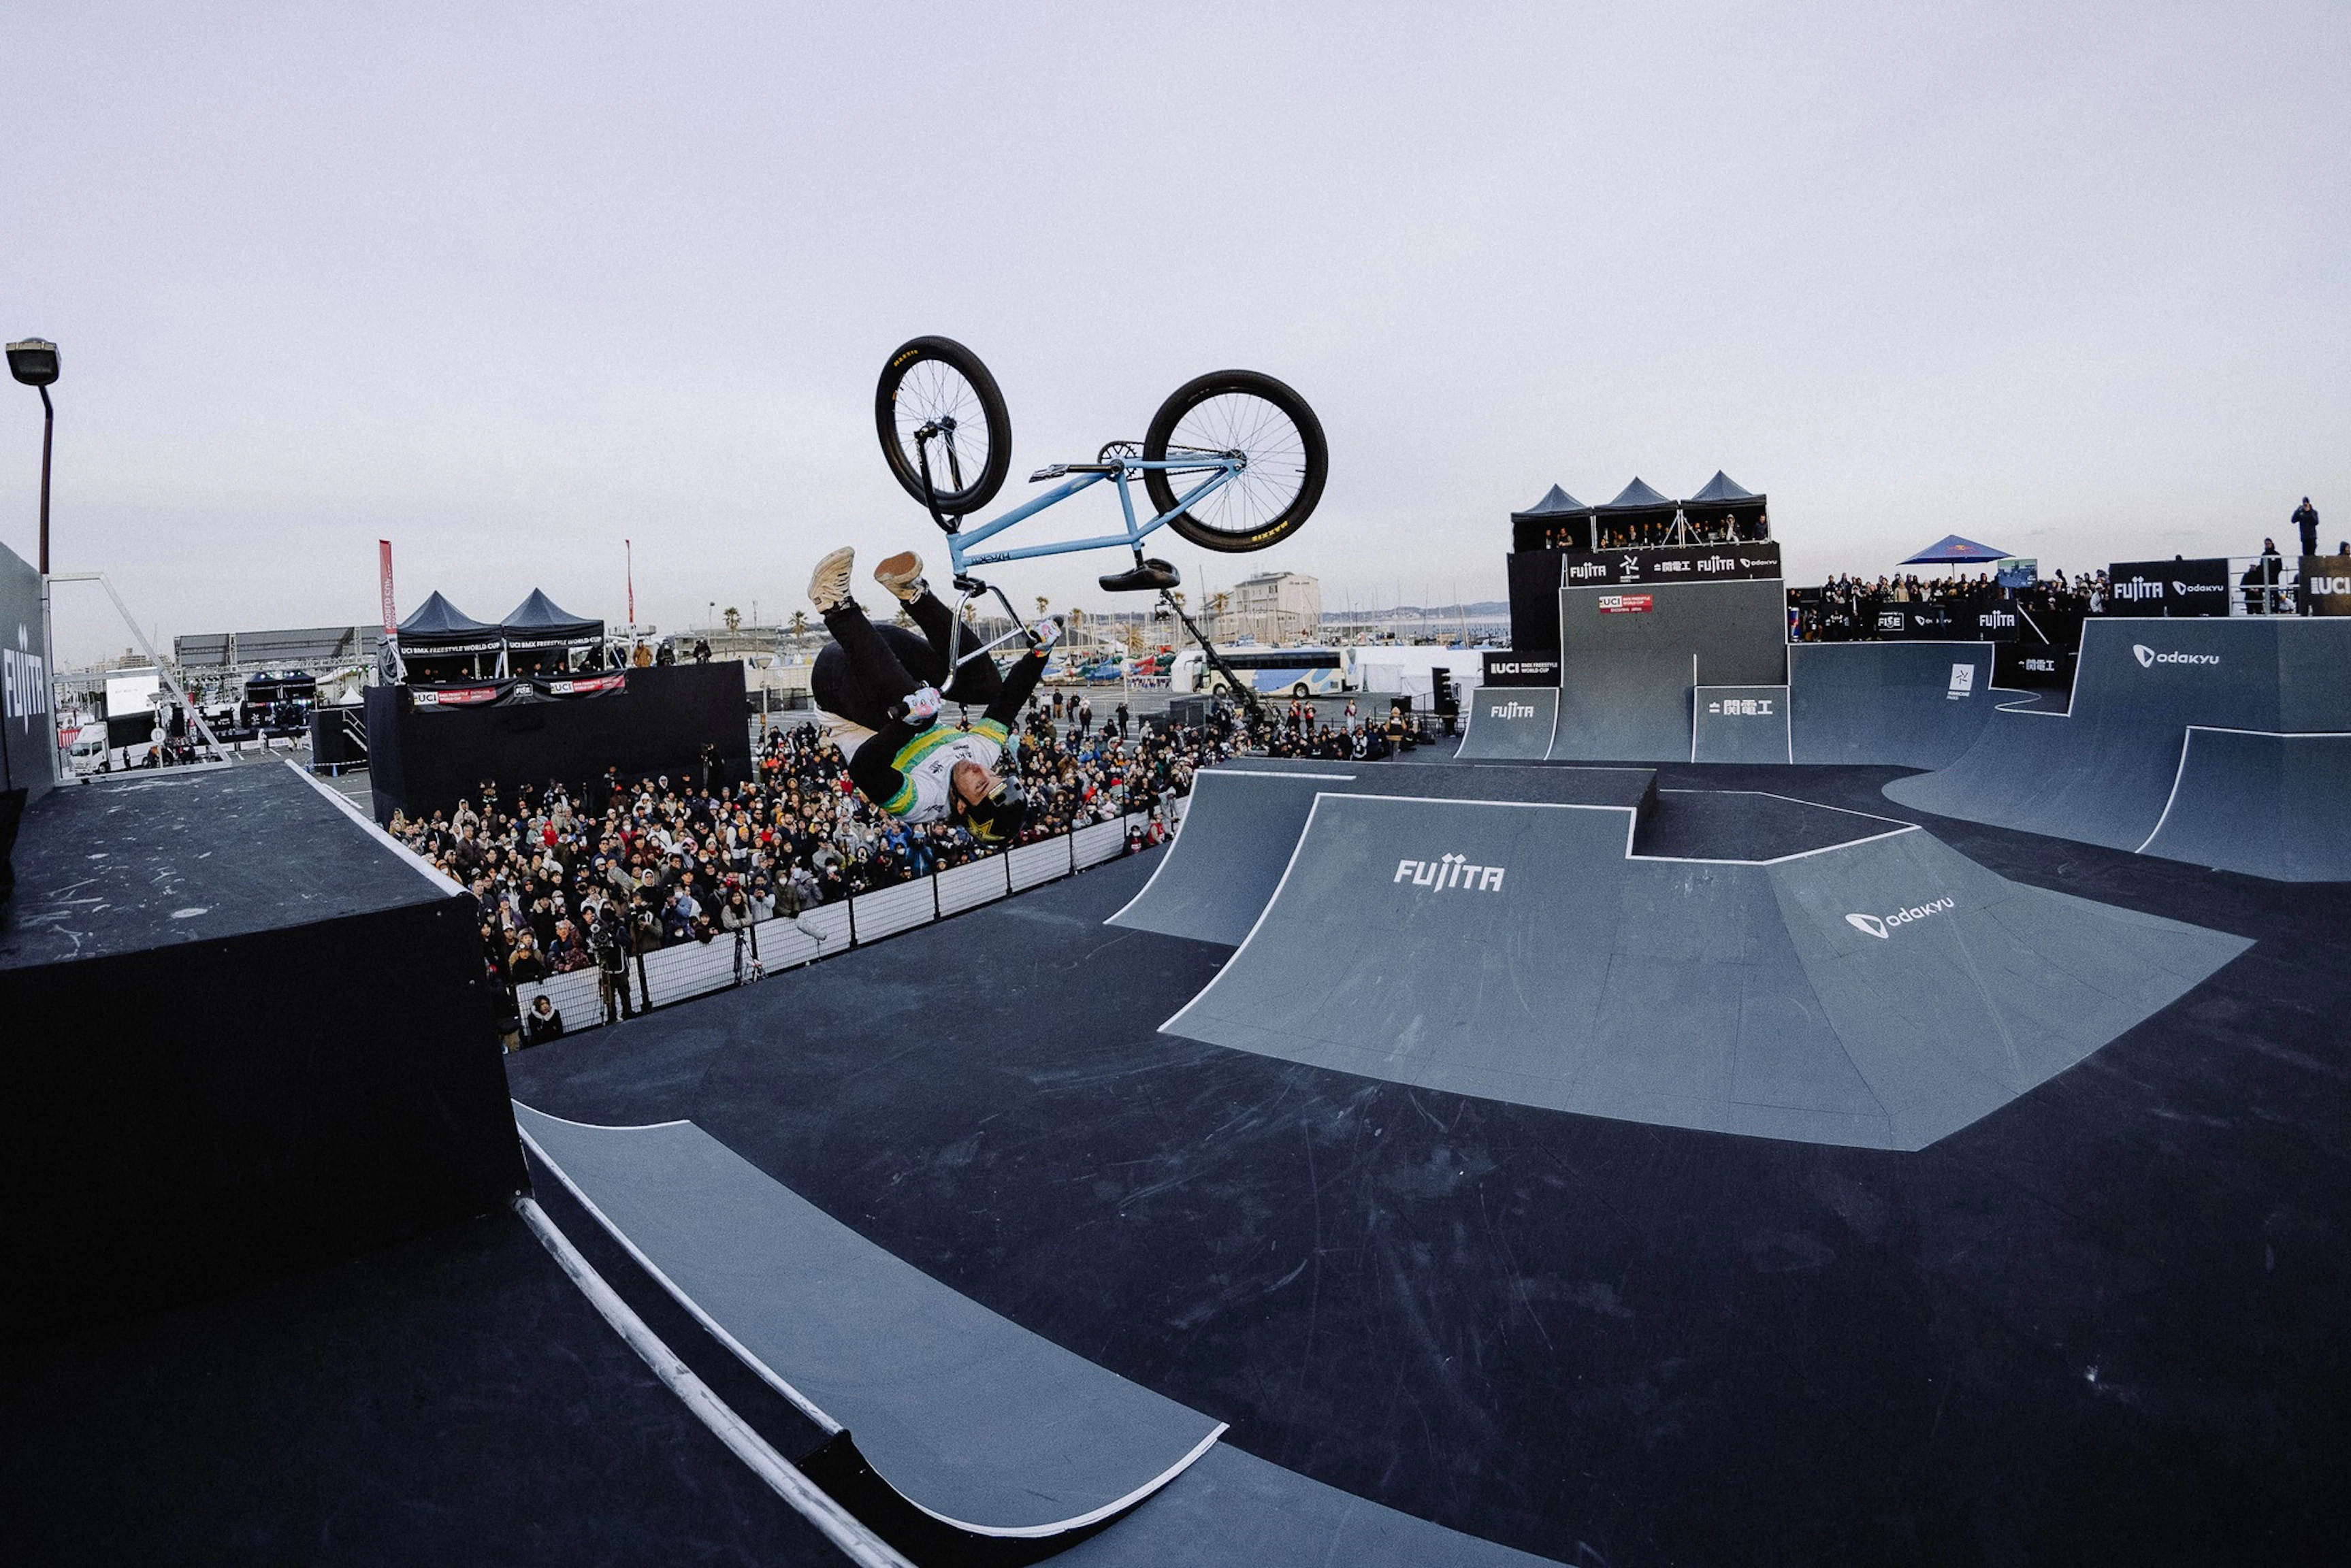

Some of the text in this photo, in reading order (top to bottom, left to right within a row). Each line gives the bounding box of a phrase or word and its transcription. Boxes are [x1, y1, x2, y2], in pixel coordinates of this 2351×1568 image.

[2187, 584, 2224, 592] odakyu
[2156, 651, 2220, 664] odakyu
[1723, 700, 1773, 715] 関電工
[1885, 897, 1955, 926] odakyu
